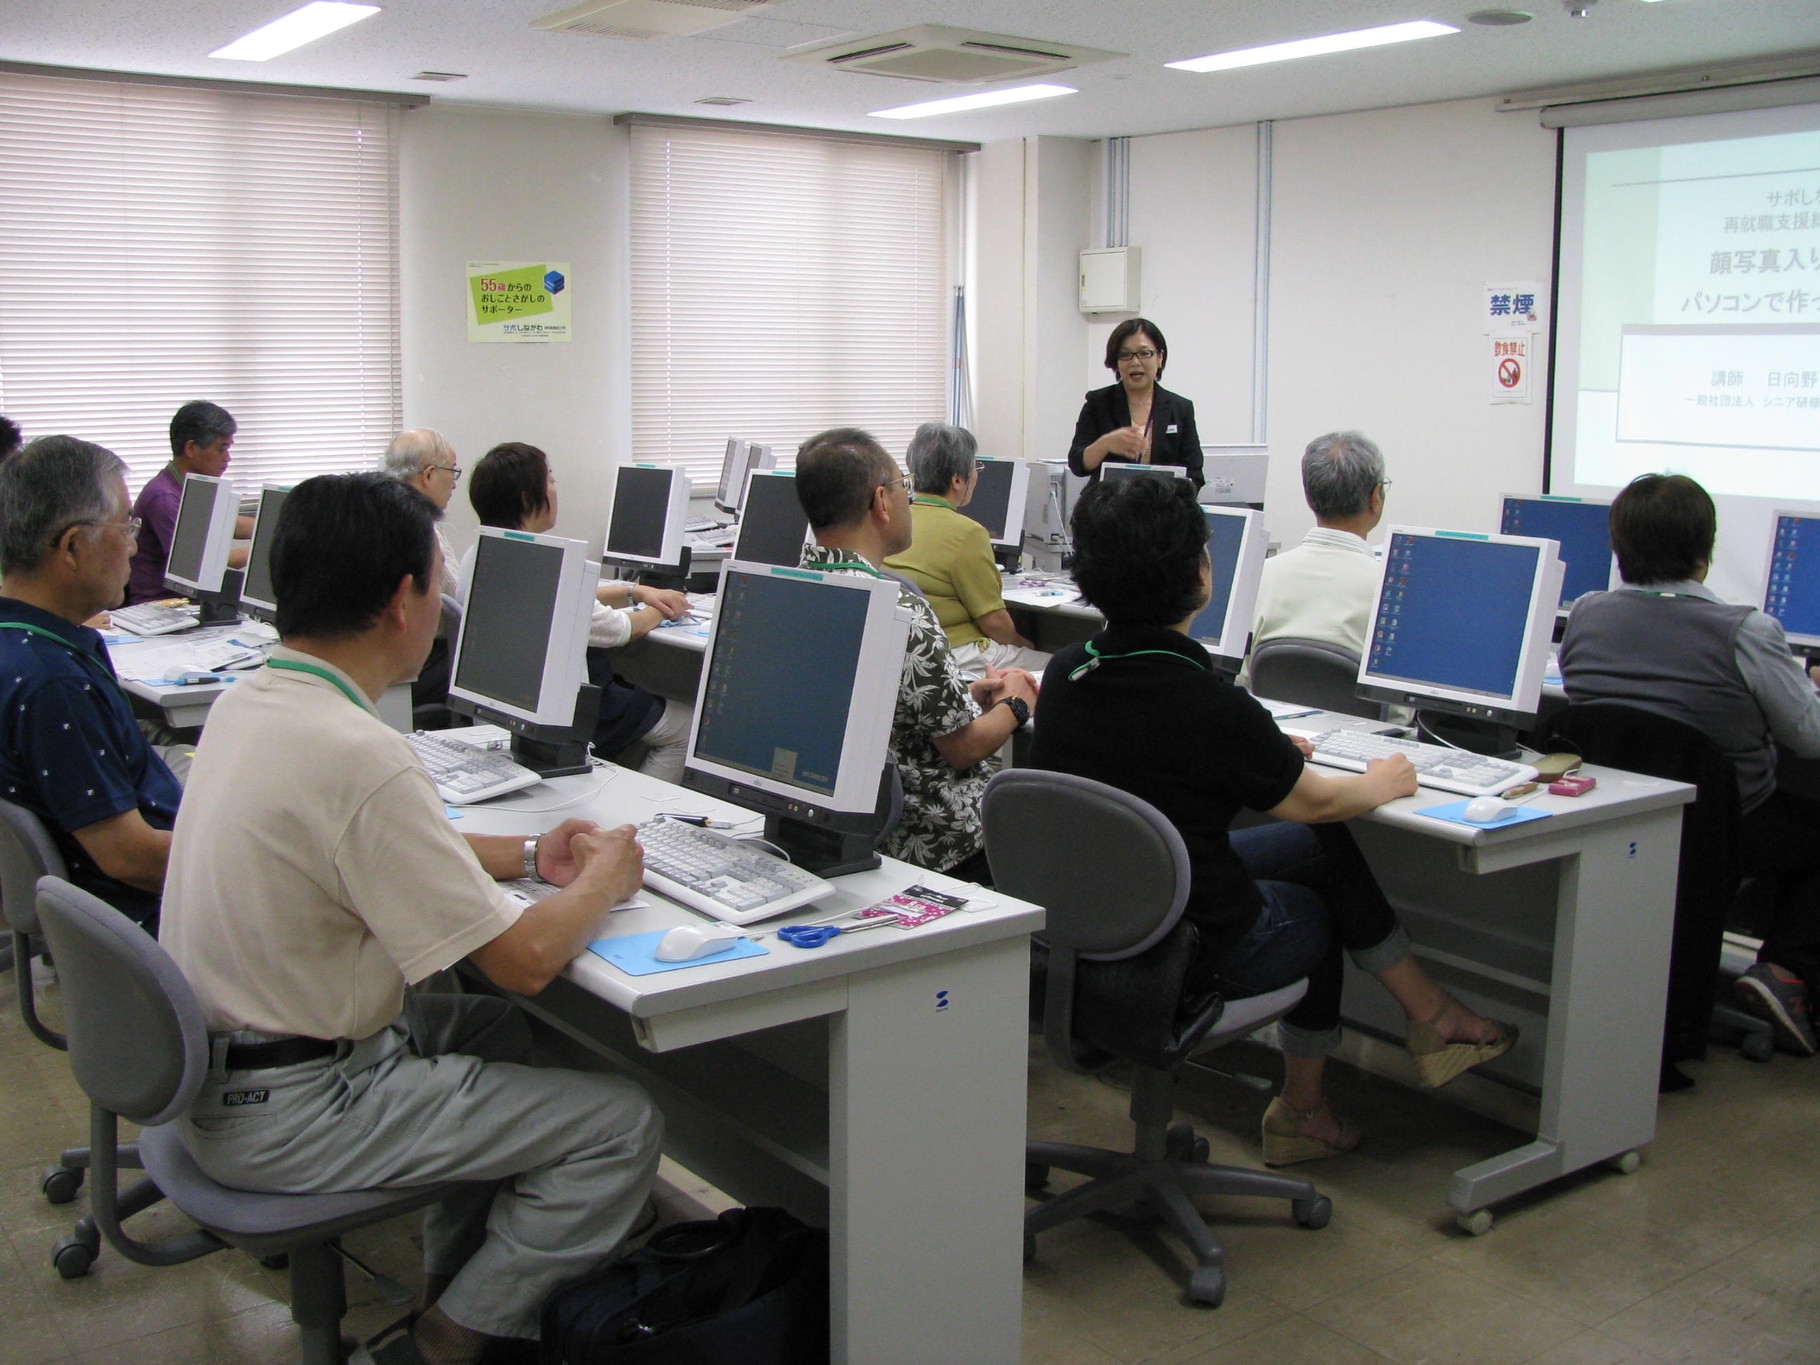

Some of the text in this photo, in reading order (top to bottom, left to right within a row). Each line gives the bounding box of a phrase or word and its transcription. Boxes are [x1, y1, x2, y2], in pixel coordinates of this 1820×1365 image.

[482, 305, 523, 314] サポーター
[1489, 293, 1535, 316] 禁煙
[1494, 340, 1526, 358] 飲食禁止
[1710, 369, 1819, 389] 講師 日向野
